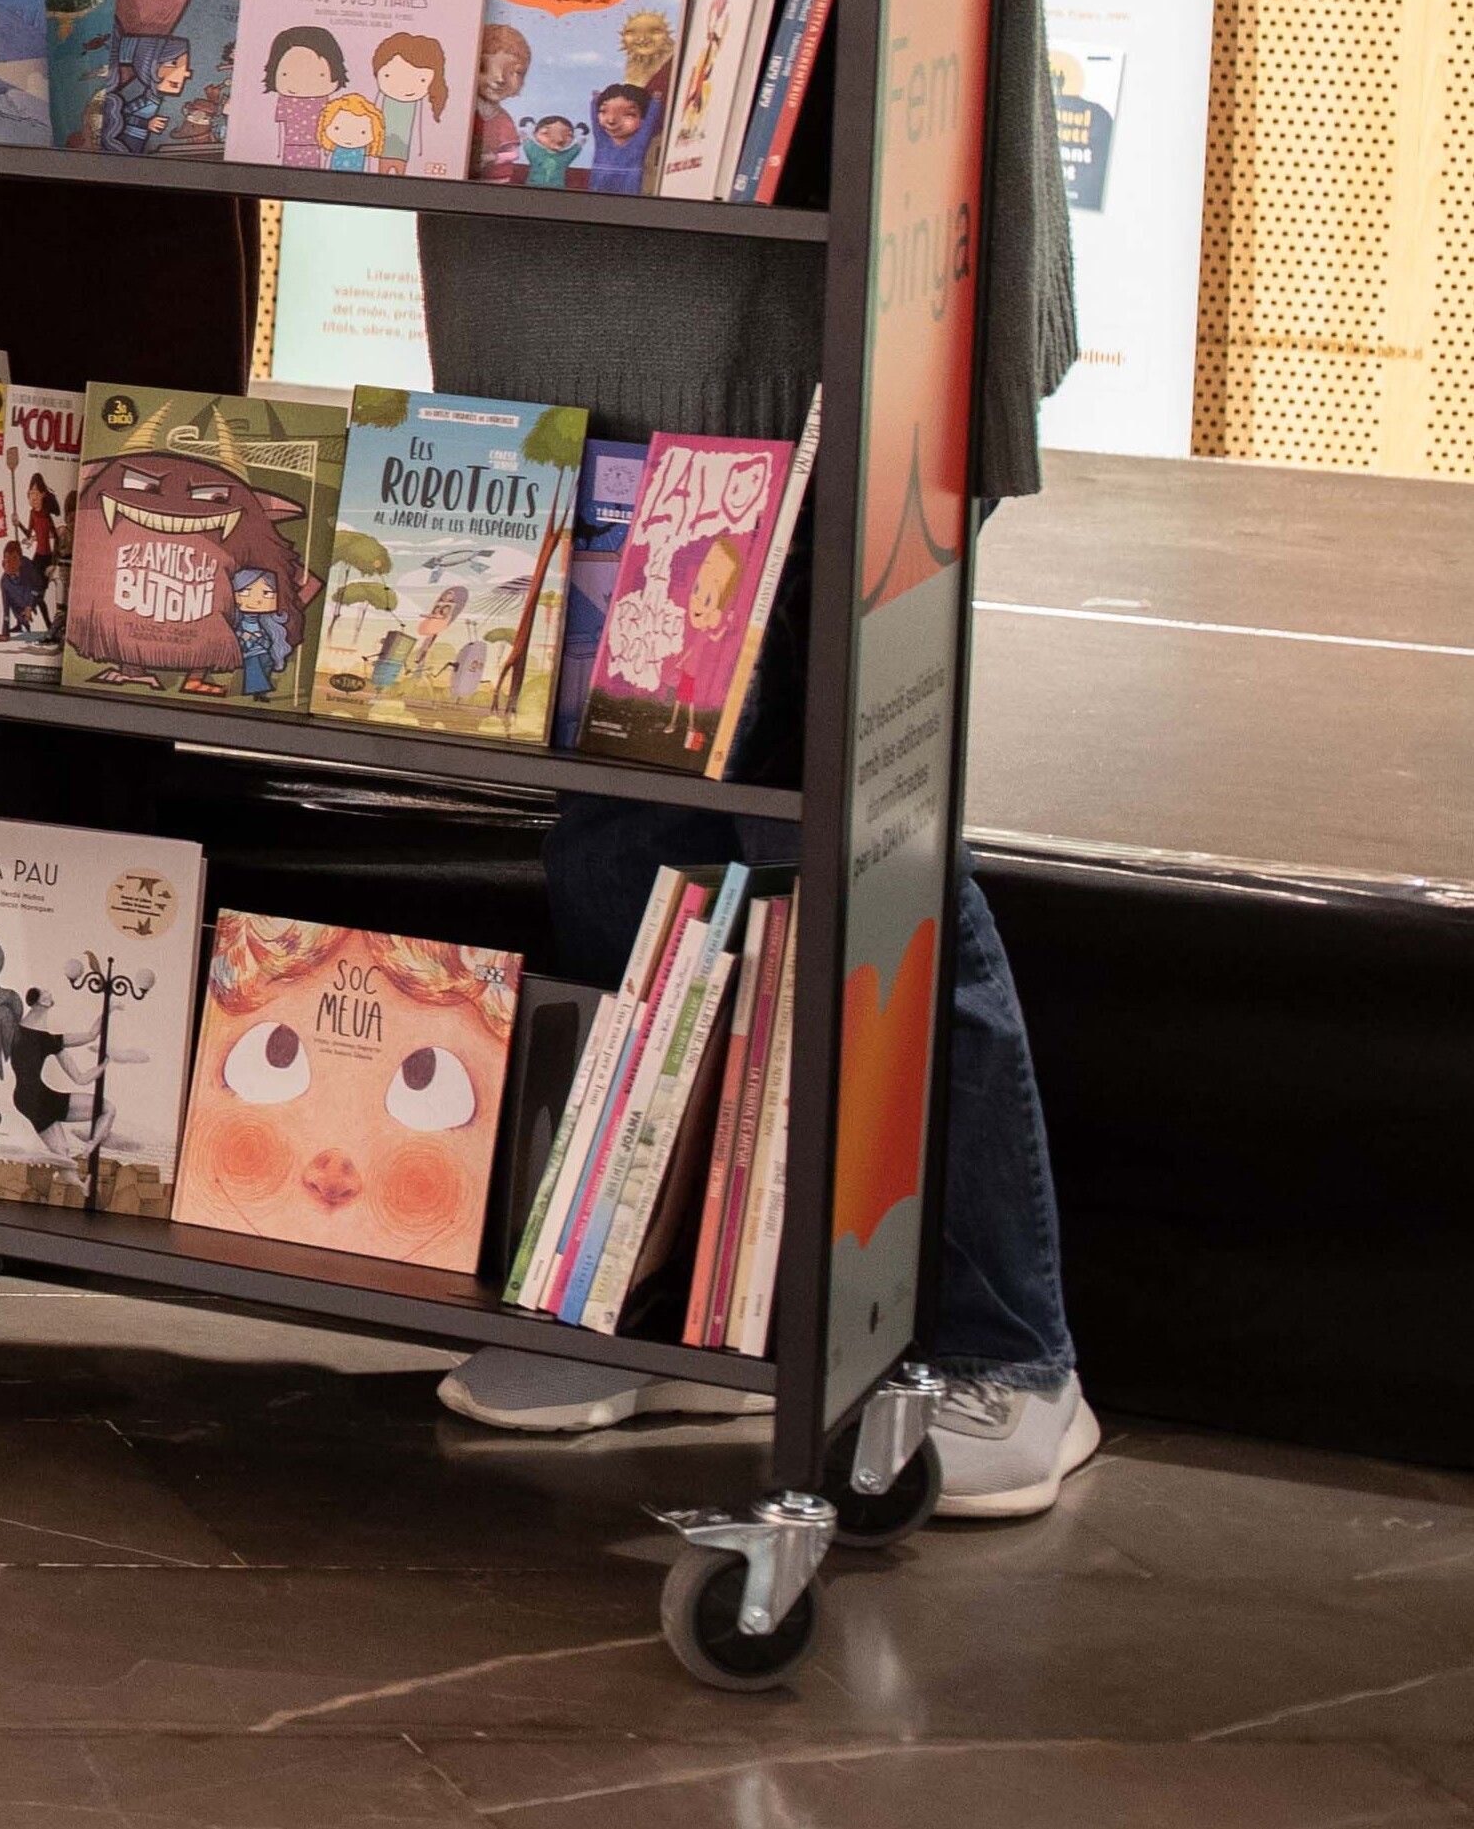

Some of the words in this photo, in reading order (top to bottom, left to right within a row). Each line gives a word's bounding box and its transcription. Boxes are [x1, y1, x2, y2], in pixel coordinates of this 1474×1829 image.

[22, 407, 85, 455] COLL
[409, 436, 434, 461] ELS
[381, 456, 540, 519] ROBOTOTS
[389, 509, 428, 529] JARDÍ
[432, 517, 443, 532] DE
[469, 517, 539, 541] HESPÈRIDES
[116, 543, 143, 570] Els
[195, 552, 218, 582] del
[114, 568, 215, 624] BUTONI
[14, 859, 59, 886] PAU
[334, 959, 381, 995] SOC
[316, 992, 382, 1042] MEUA
